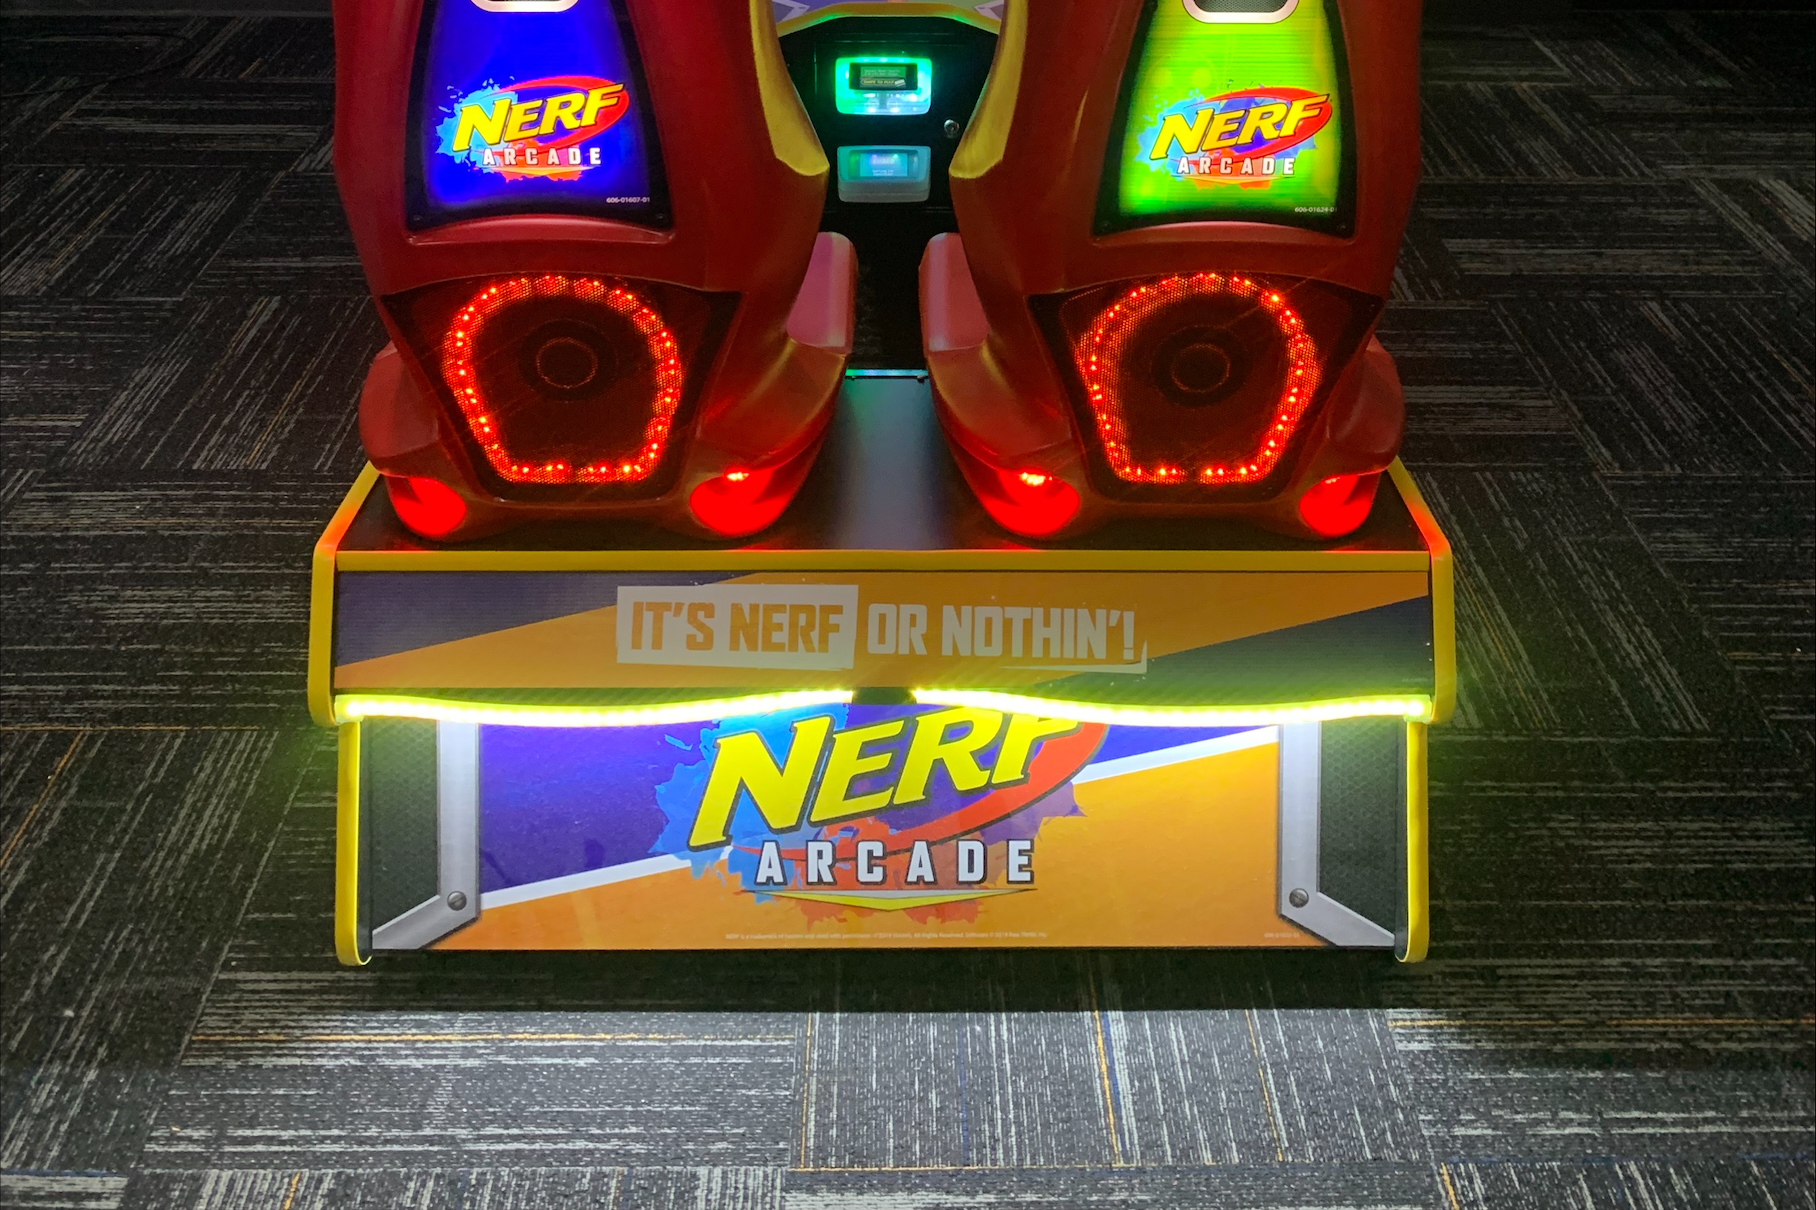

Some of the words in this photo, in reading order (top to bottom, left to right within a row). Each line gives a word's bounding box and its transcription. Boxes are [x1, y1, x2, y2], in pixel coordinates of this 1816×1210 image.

[452, 83, 624, 152] NERF
[1149, 93, 1330, 160] NERF
[482, 147, 601, 165] ARCADE
[1177, 156, 1295, 175] ARCADE
[631, 602, 714, 652] IT'S
[729, 602, 842, 654] NERF
[866, 603, 928, 656] OR
[941, 604, 1136, 660] NOTHIN'!
[689, 705, 1079, 850] NERF
[754, 838, 1034, 885] ARCADE
